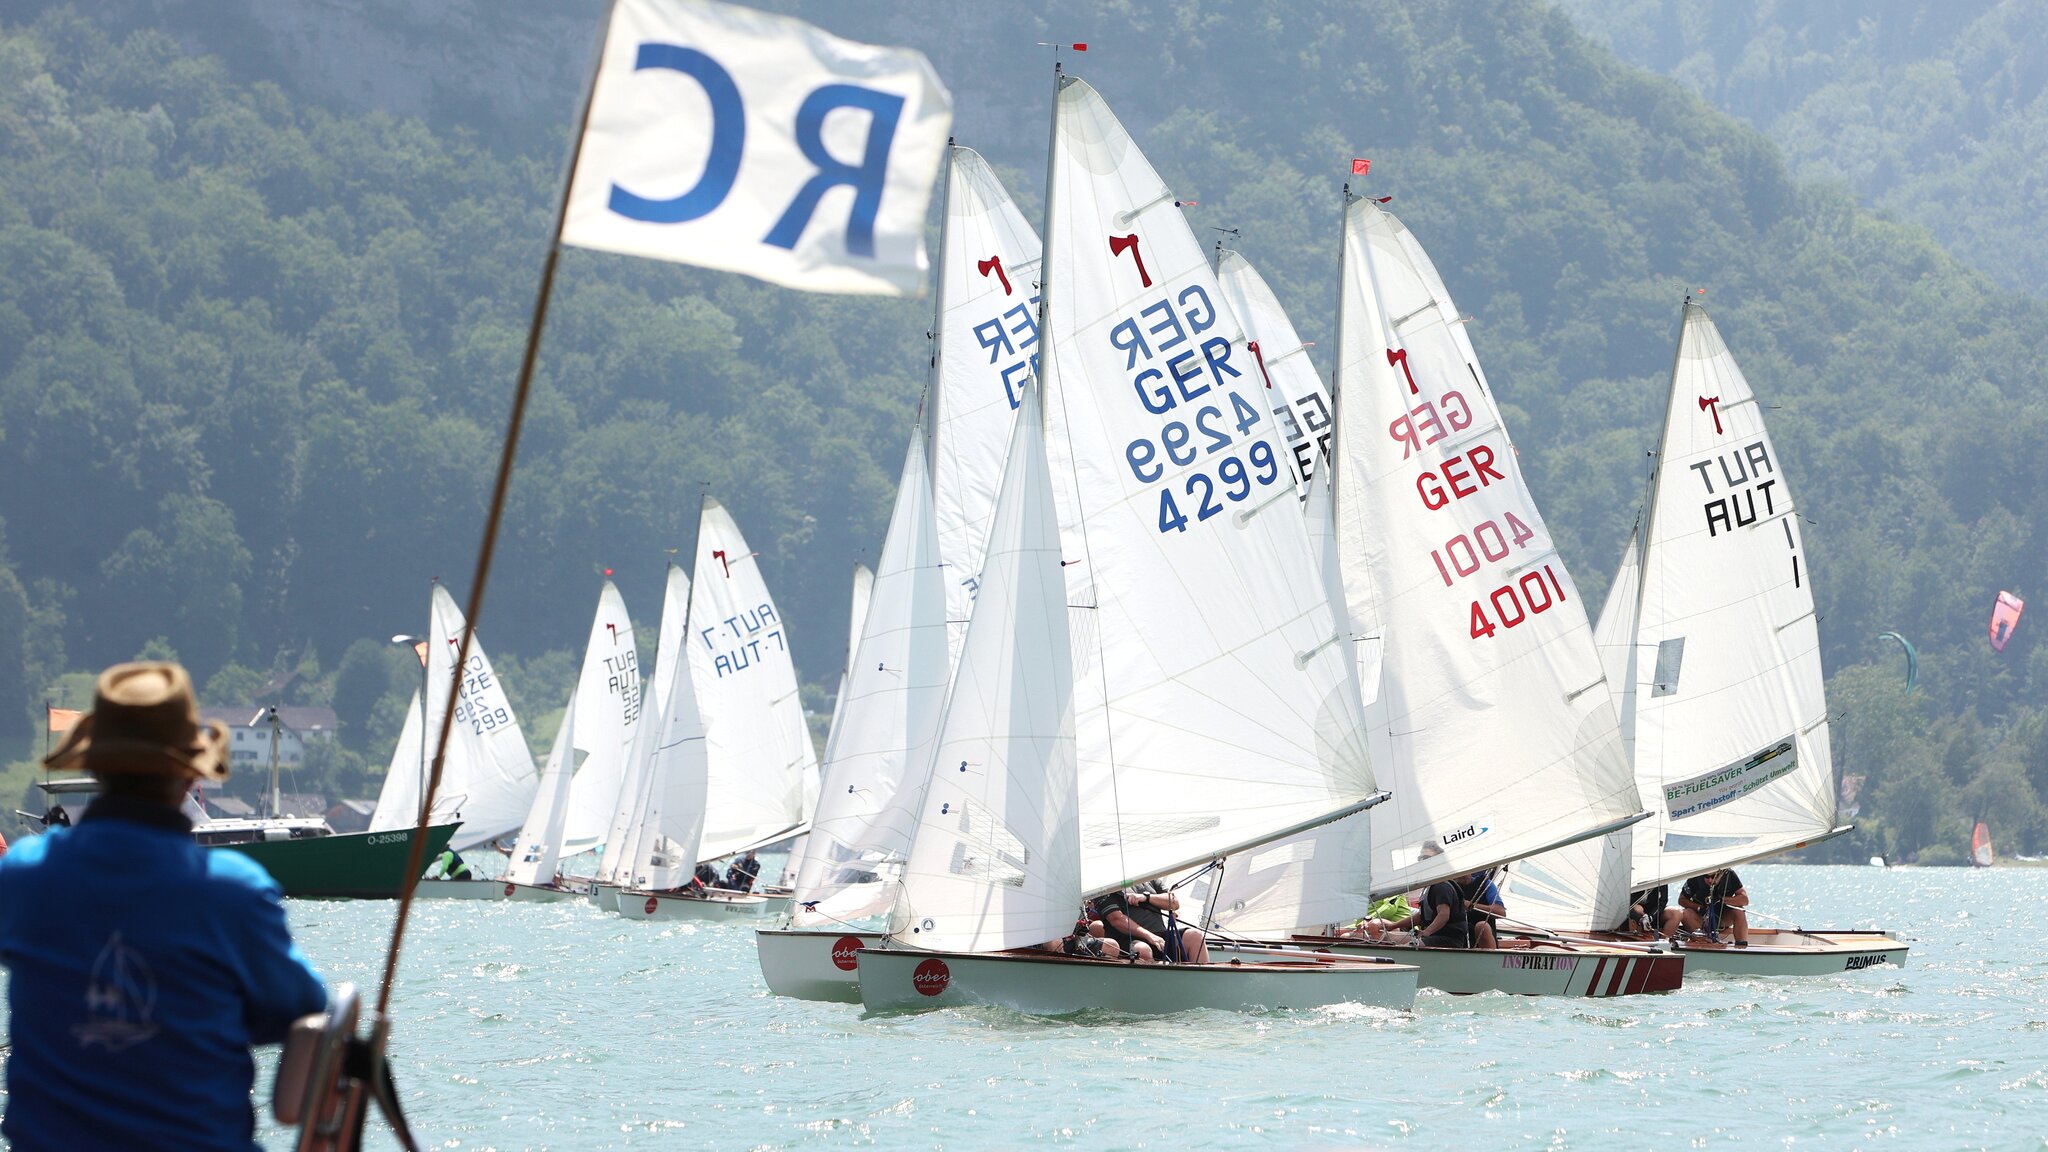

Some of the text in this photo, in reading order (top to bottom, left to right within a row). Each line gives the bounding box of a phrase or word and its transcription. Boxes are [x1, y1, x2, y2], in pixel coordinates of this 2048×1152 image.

[1134, 336, 1242, 414] GER
[1158, 440, 1278, 533] 4299
[1416, 445, 1505, 511] GER
[1704, 479, 1776, 537] AUT
[1470, 565, 1566, 639] 4001
[459, 672, 492, 699] CZE
[609, 668, 637, 694] AUT
[472, 708, 508, 735] 299
[1667, 767, 1743, 800] BE-FUELSAVER
[1671, 806, 1695, 818] Spart
[1698, 790, 1737, 810] Treibstoff
[1743, 774, 1769, 793] Schützt
[1770, 760, 1796, 778] Umwelt
[1443, 825, 1475, 845] Laird
[831, 946, 857, 958] obe
[1502, 955, 1575, 970] INSPIRATION
[1846, 954, 1887, 968] PRIMUS
